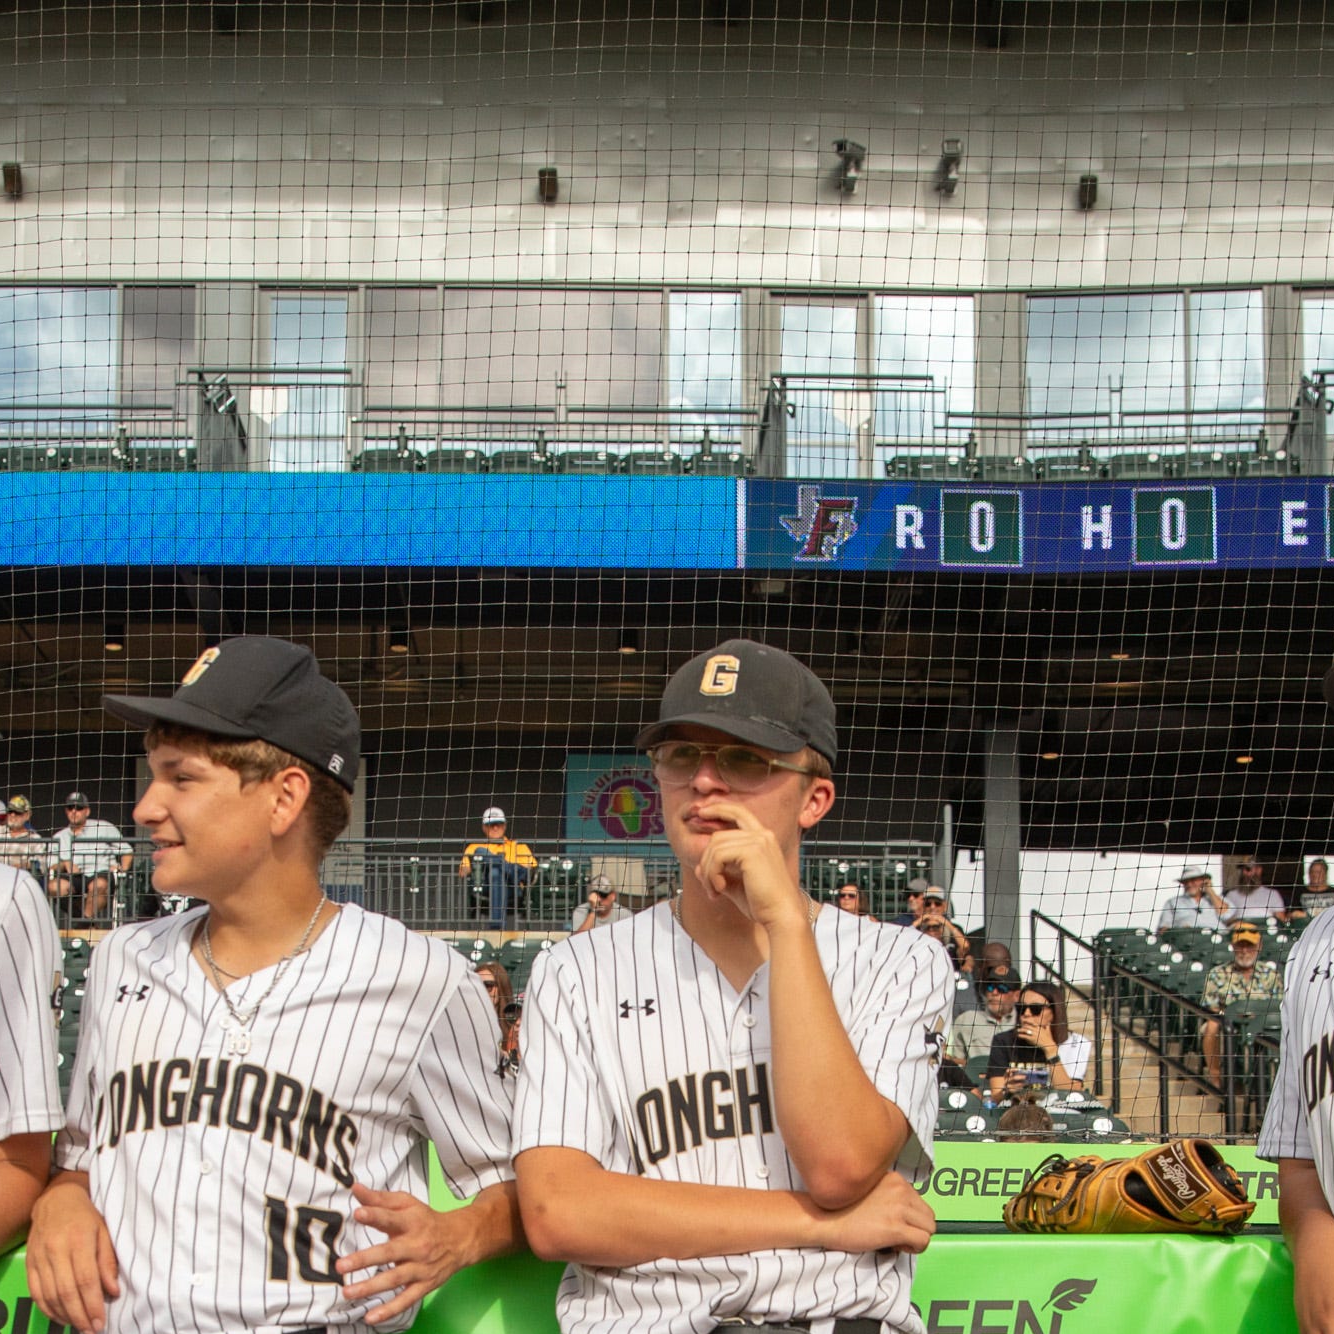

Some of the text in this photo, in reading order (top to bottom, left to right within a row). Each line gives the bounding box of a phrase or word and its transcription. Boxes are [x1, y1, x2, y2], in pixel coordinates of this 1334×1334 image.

[895, 504, 925, 550] R
[1081, 504, 1113, 550] H
[1282, 500, 1309, 546] E
[699, 653, 741, 697] G
[95, 1057, 359, 1189] ONGHORNS
[625, 1062, 775, 1176] ONGH
[267, 1195, 345, 1286] 10
